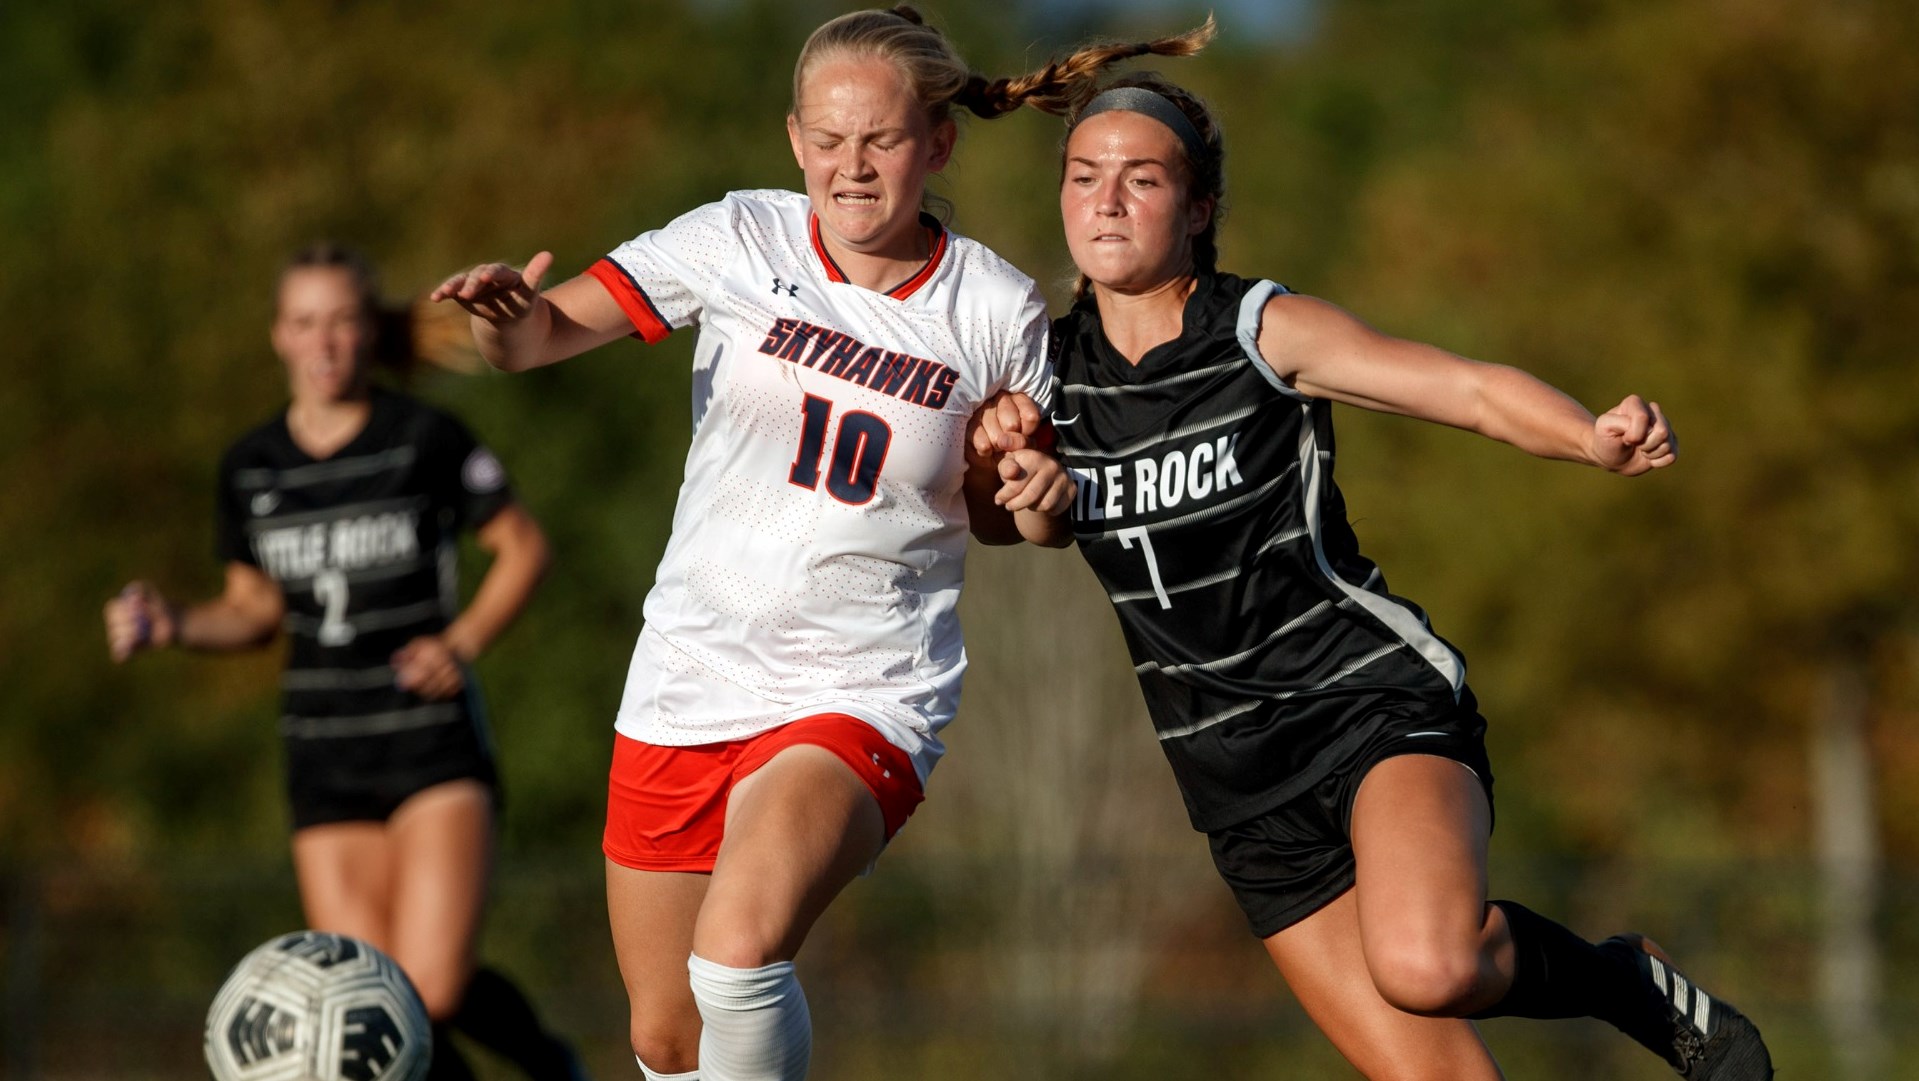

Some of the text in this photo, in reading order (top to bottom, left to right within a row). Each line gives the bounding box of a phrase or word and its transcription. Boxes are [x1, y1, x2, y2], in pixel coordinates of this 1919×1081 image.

[757, 317, 960, 411] SKYHAWKS
[788, 391, 893, 506] 10
[1066, 431, 1244, 520] TLE ROCK
[328, 511, 419, 571] ROCK
[1116, 525, 1173, 610] 7
[312, 567, 356, 648] 2
